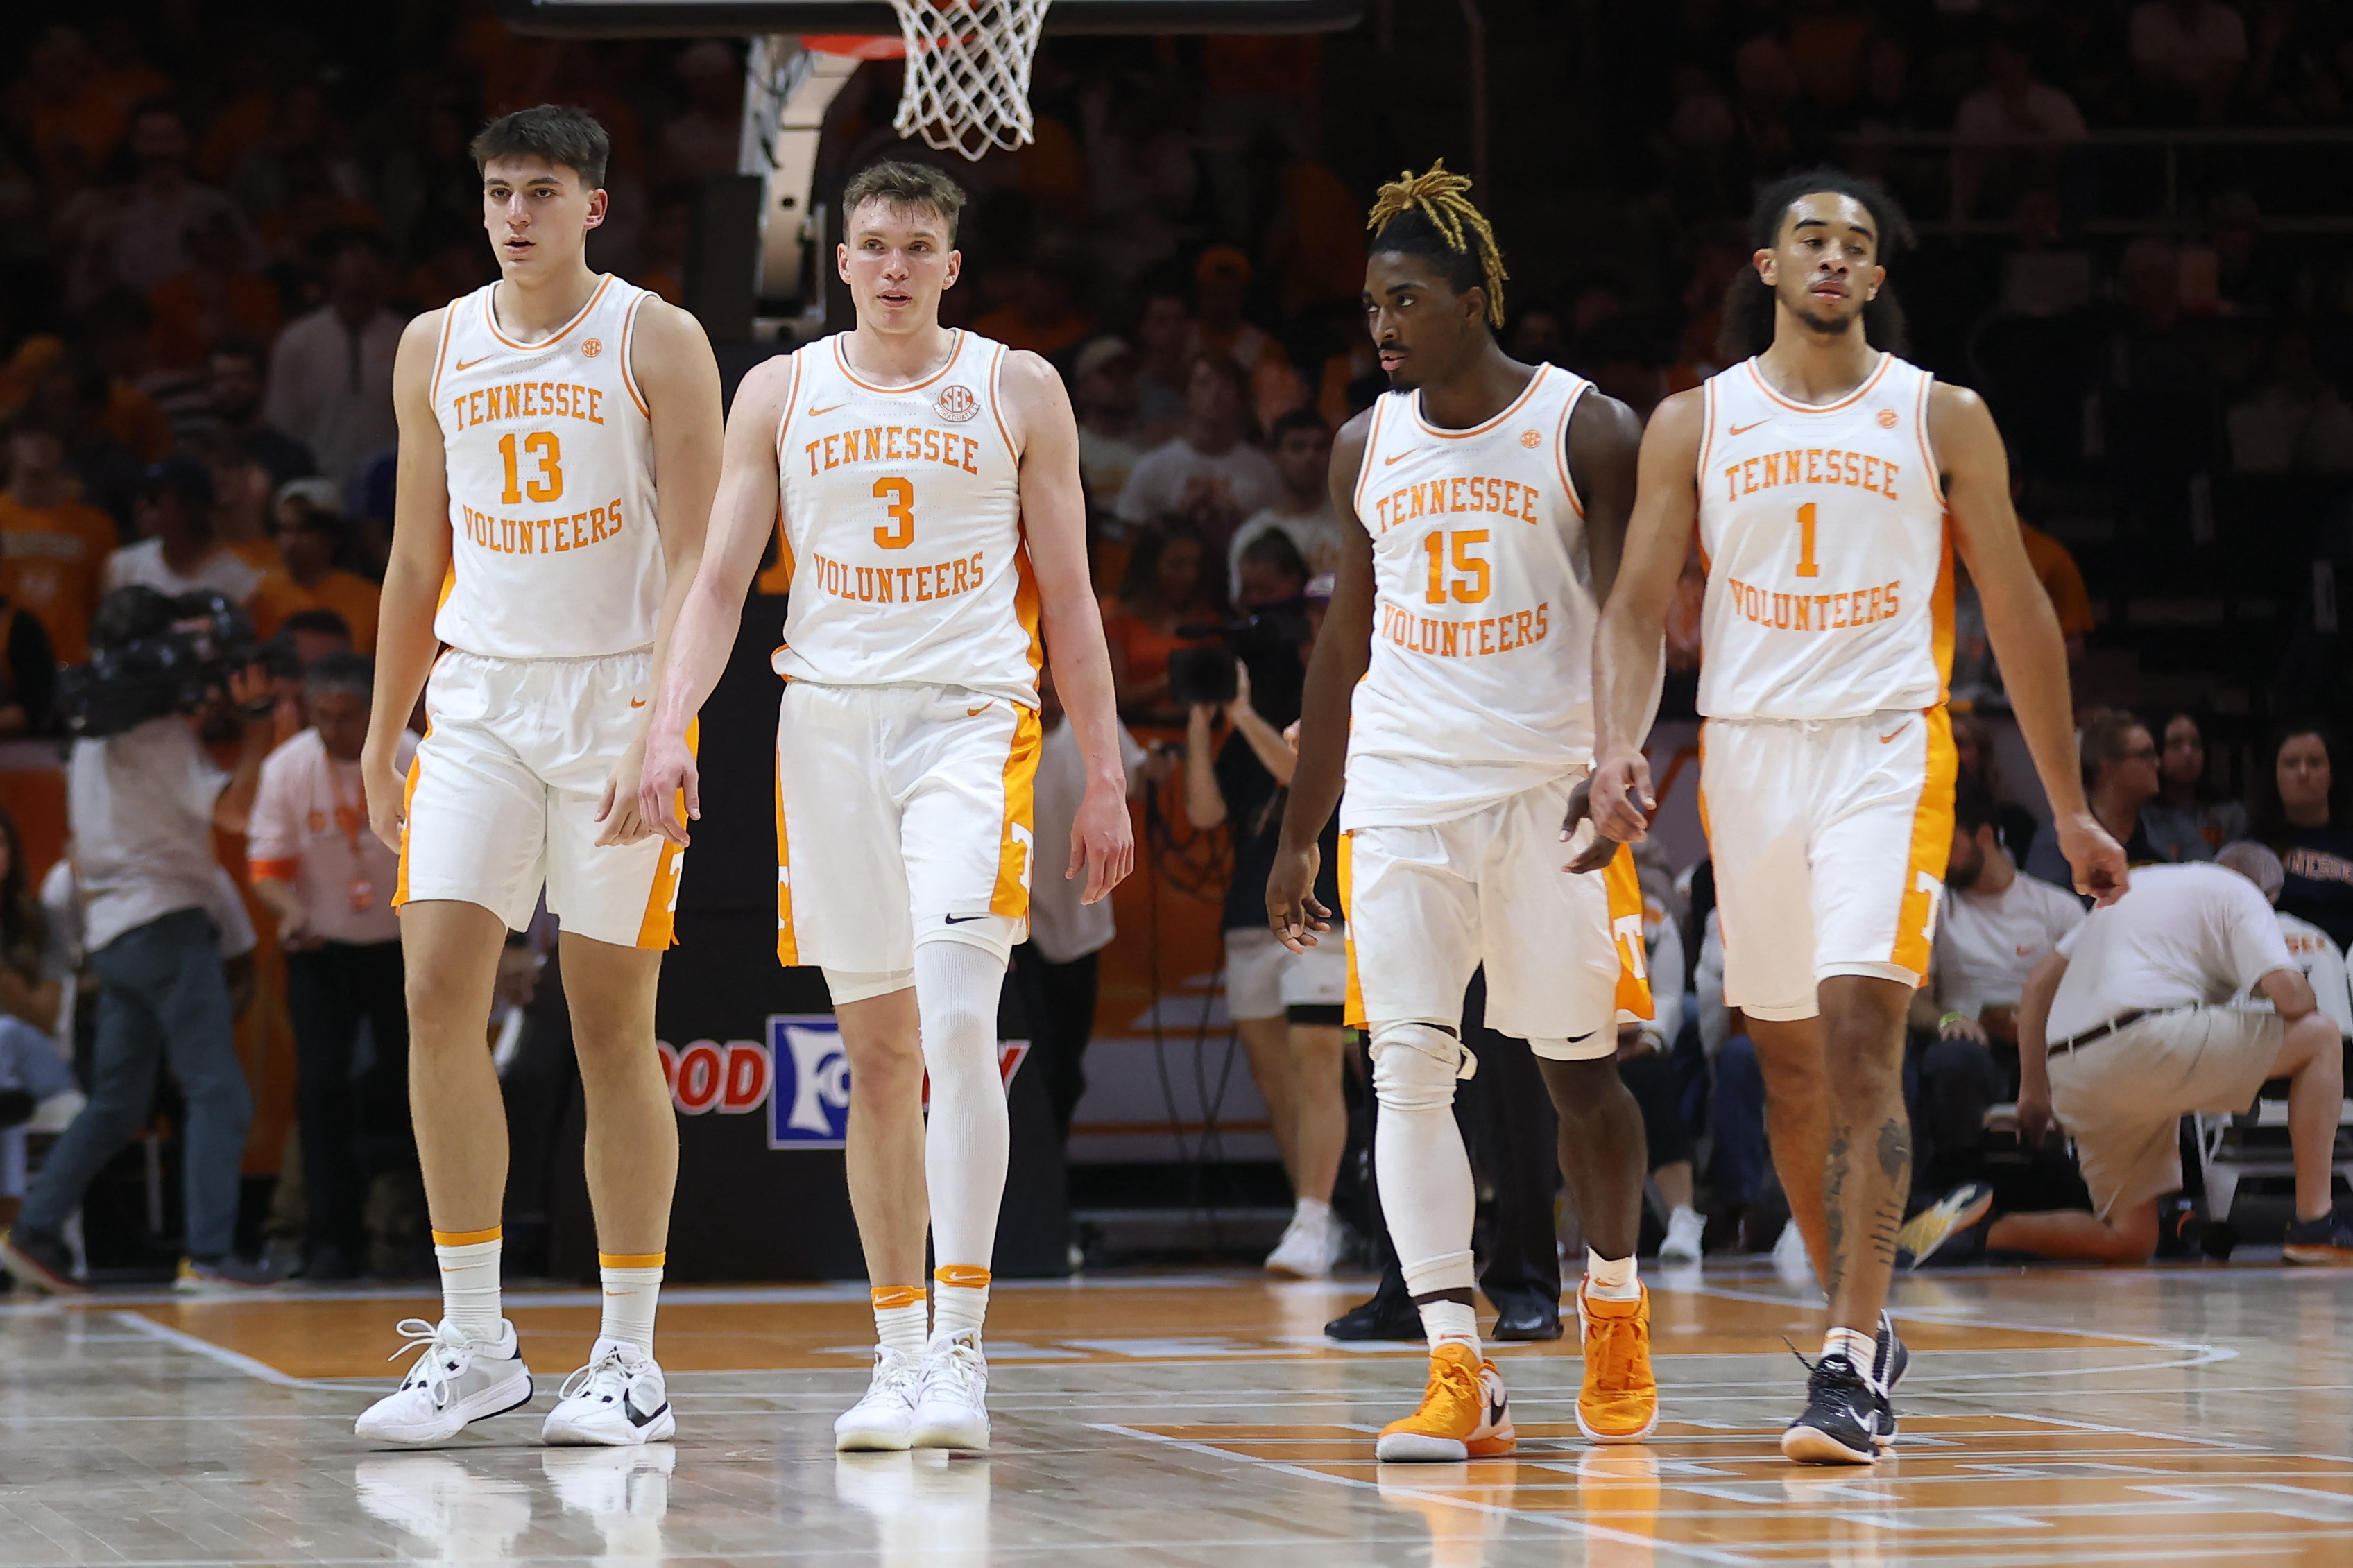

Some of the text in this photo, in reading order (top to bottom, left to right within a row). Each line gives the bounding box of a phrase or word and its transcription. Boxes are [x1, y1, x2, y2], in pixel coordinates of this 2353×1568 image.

[583, 339, 601, 356] SEC
[454, 383, 604, 431] TENNESSEE
[939, 409, 975, 421] GRADUATE
[942, 386, 973, 412] SEC
[498, 431, 564, 504] 13
[806, 427, 979, 478] TENNESSEE
[1725, 449, 1901, 502] TENNESSEE
[462, 498, 623, 555] VOLUNTEERS
[872, 476, 915, 550] 3
[1376, 476, 1539, 534] TENNESSEE
[1423, 528, 1491, 604] 15
[1795, 502, 1820, 578] 1
[813, 551, 984, 603] VOLUNTEERS
[1382, 601, 1549, 657] VOLUNTEERS
[1728, 580, 1901, 631] VOLUNTEERS
[1613, 913, 1646, 979] T
